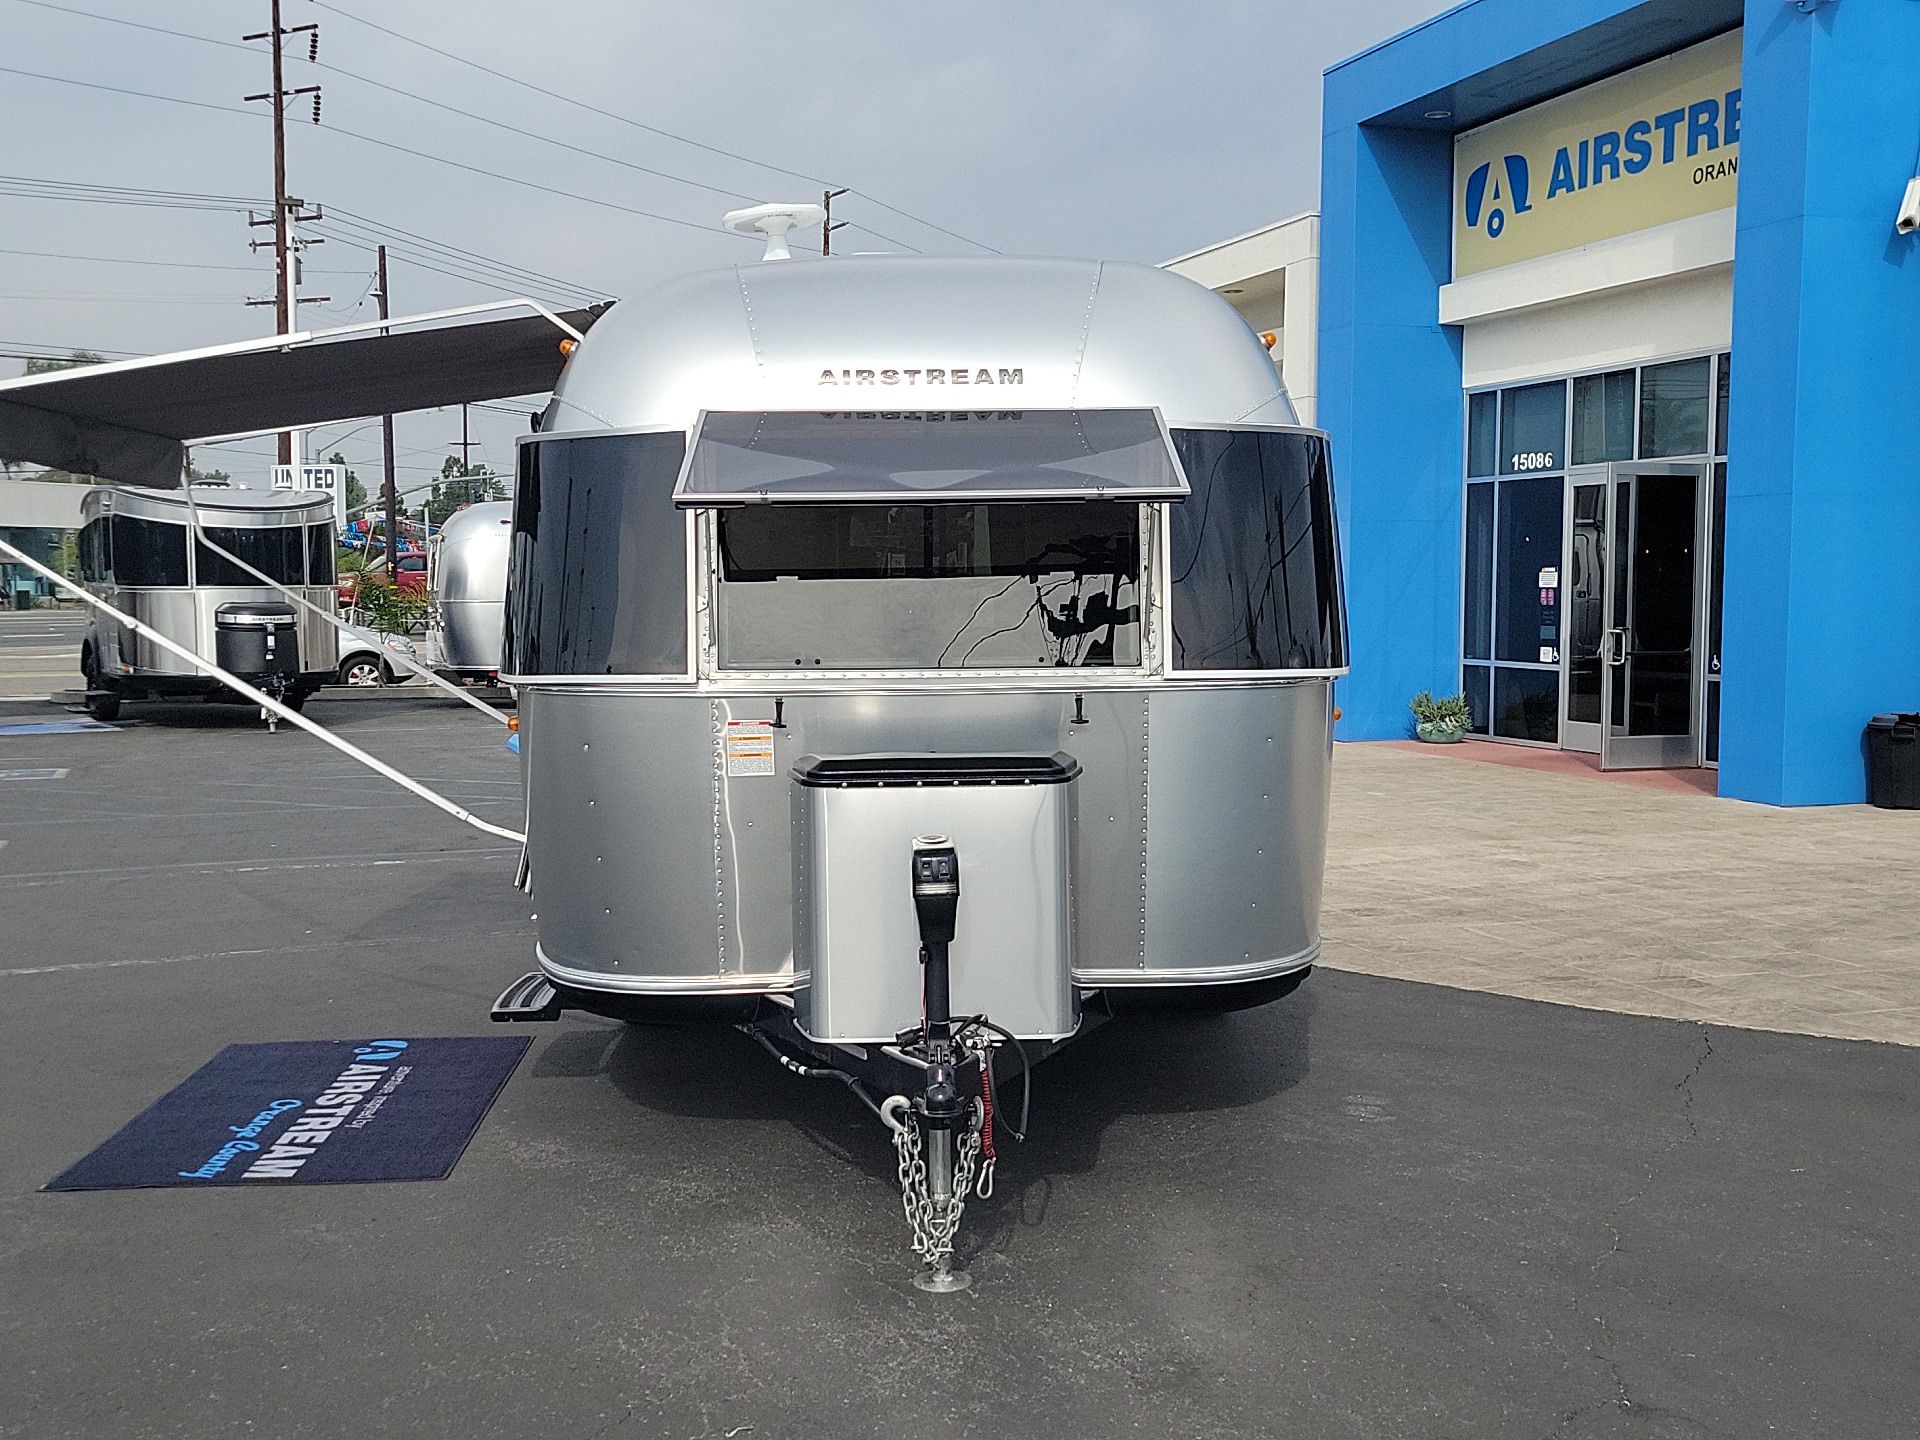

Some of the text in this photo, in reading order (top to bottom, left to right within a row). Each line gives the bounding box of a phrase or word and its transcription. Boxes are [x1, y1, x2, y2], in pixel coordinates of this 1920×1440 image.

[1692, 157, 1738, 185] ORAN
[818, 368, 1024, 386] AIRSTREAM
[1511, 452, 1553, 471] 15086
[274, 468, 335, 489] UNTED
[241, 1063, 389, 1179] AIRSTREAM
[178, 1099, 303, 1179] Orange County
